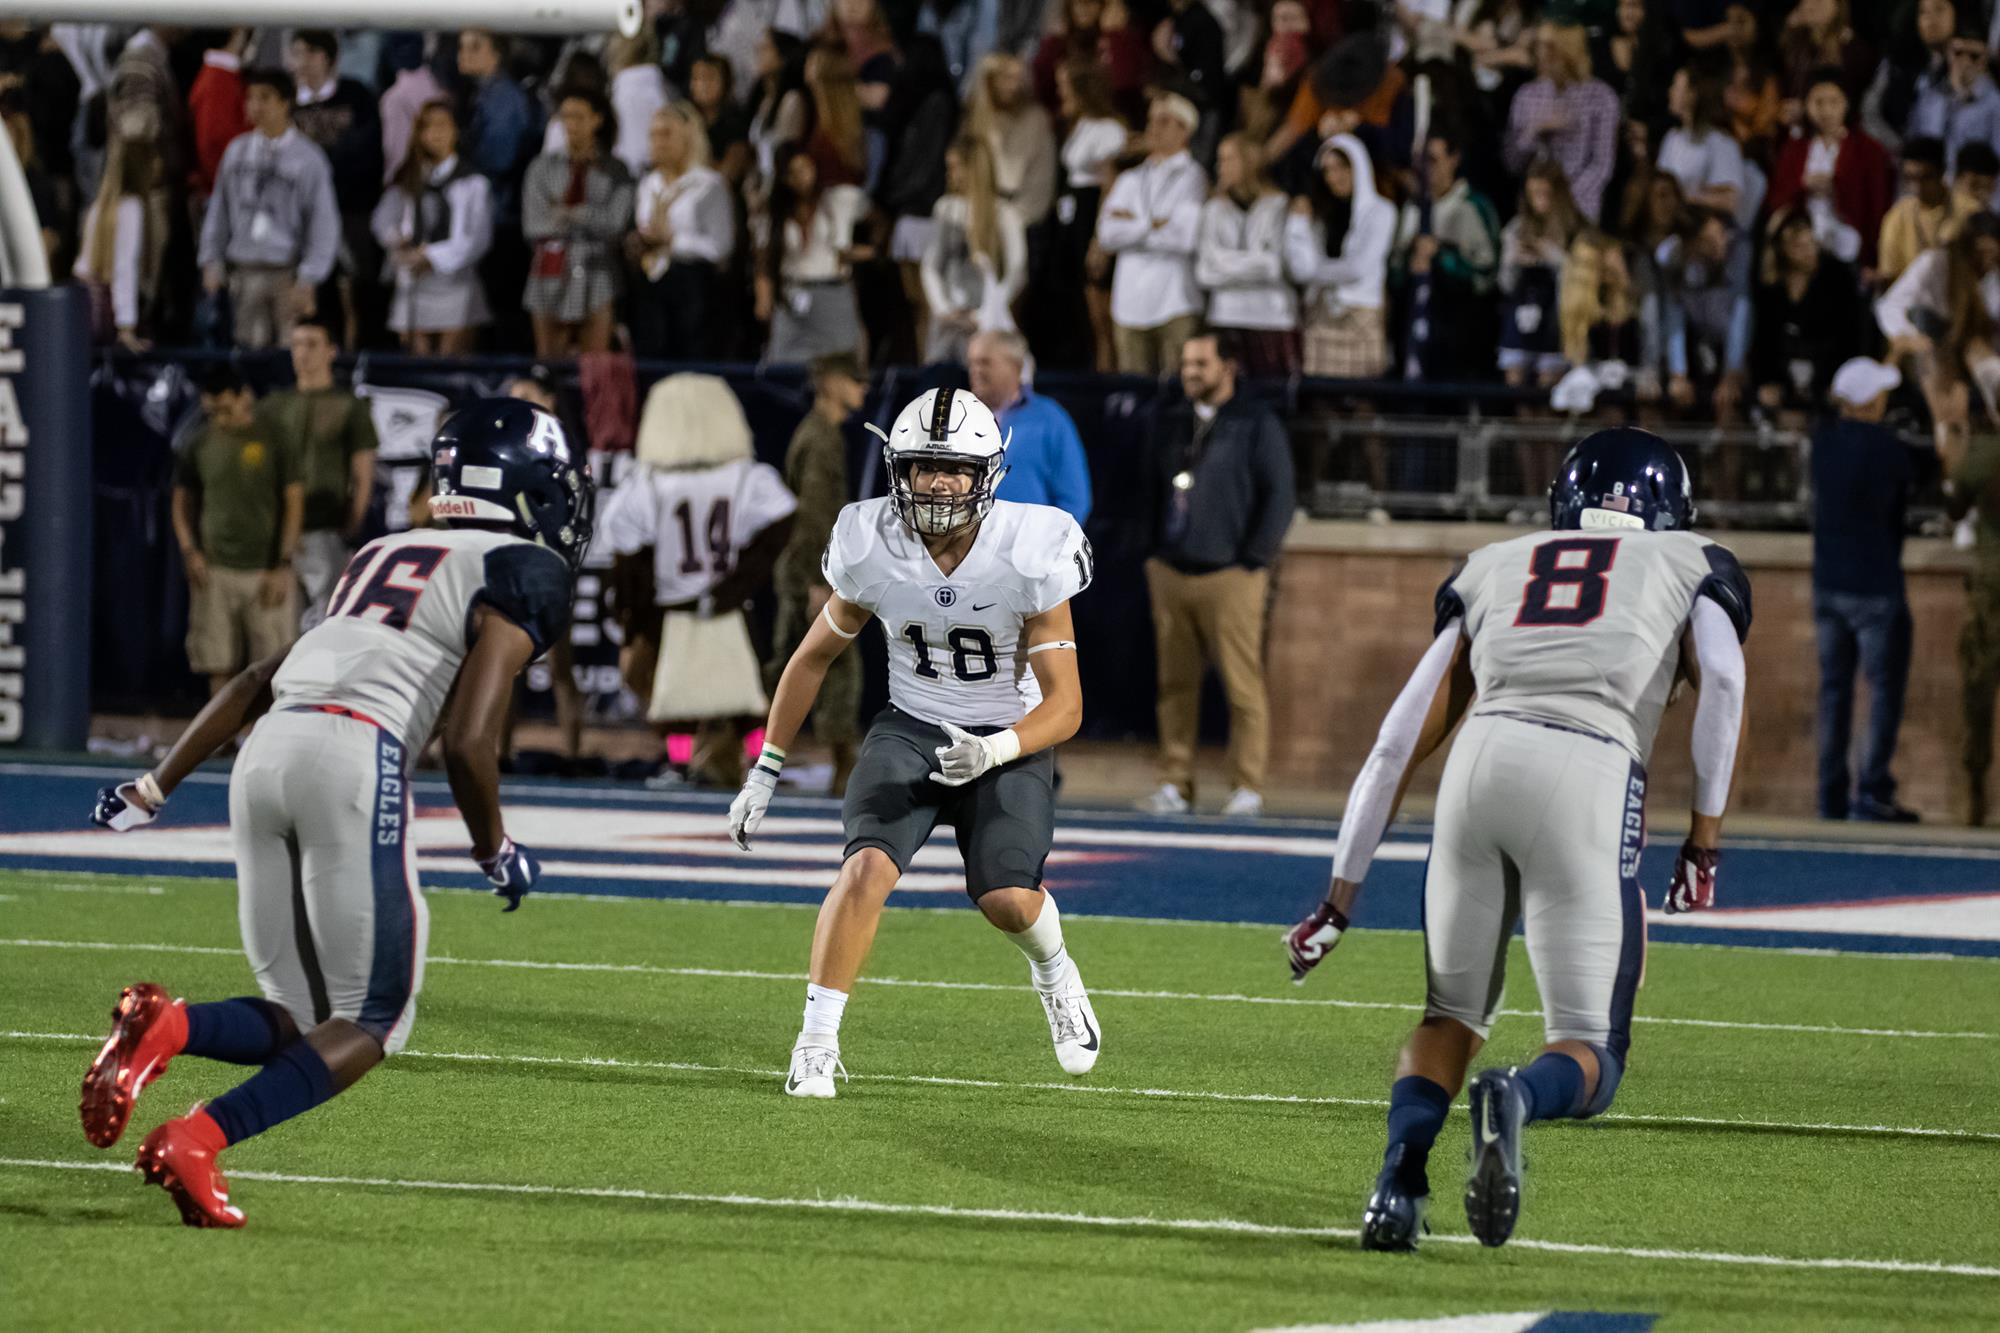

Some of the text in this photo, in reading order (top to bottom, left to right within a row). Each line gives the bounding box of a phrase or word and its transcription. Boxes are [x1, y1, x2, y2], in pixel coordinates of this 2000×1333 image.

[527, 408, 571, 464] A
[1613, 481, 1625, 496] 8
[672, 497, 738, 574] 14
[326, 544, 450, 633] 16
[1512, 537, 1622, 627] 8
[902, 620, 1000, 685] 18
[377, 741, 401, 846] EAGLES
[1621, 776, 1645, 879] EAGLES
